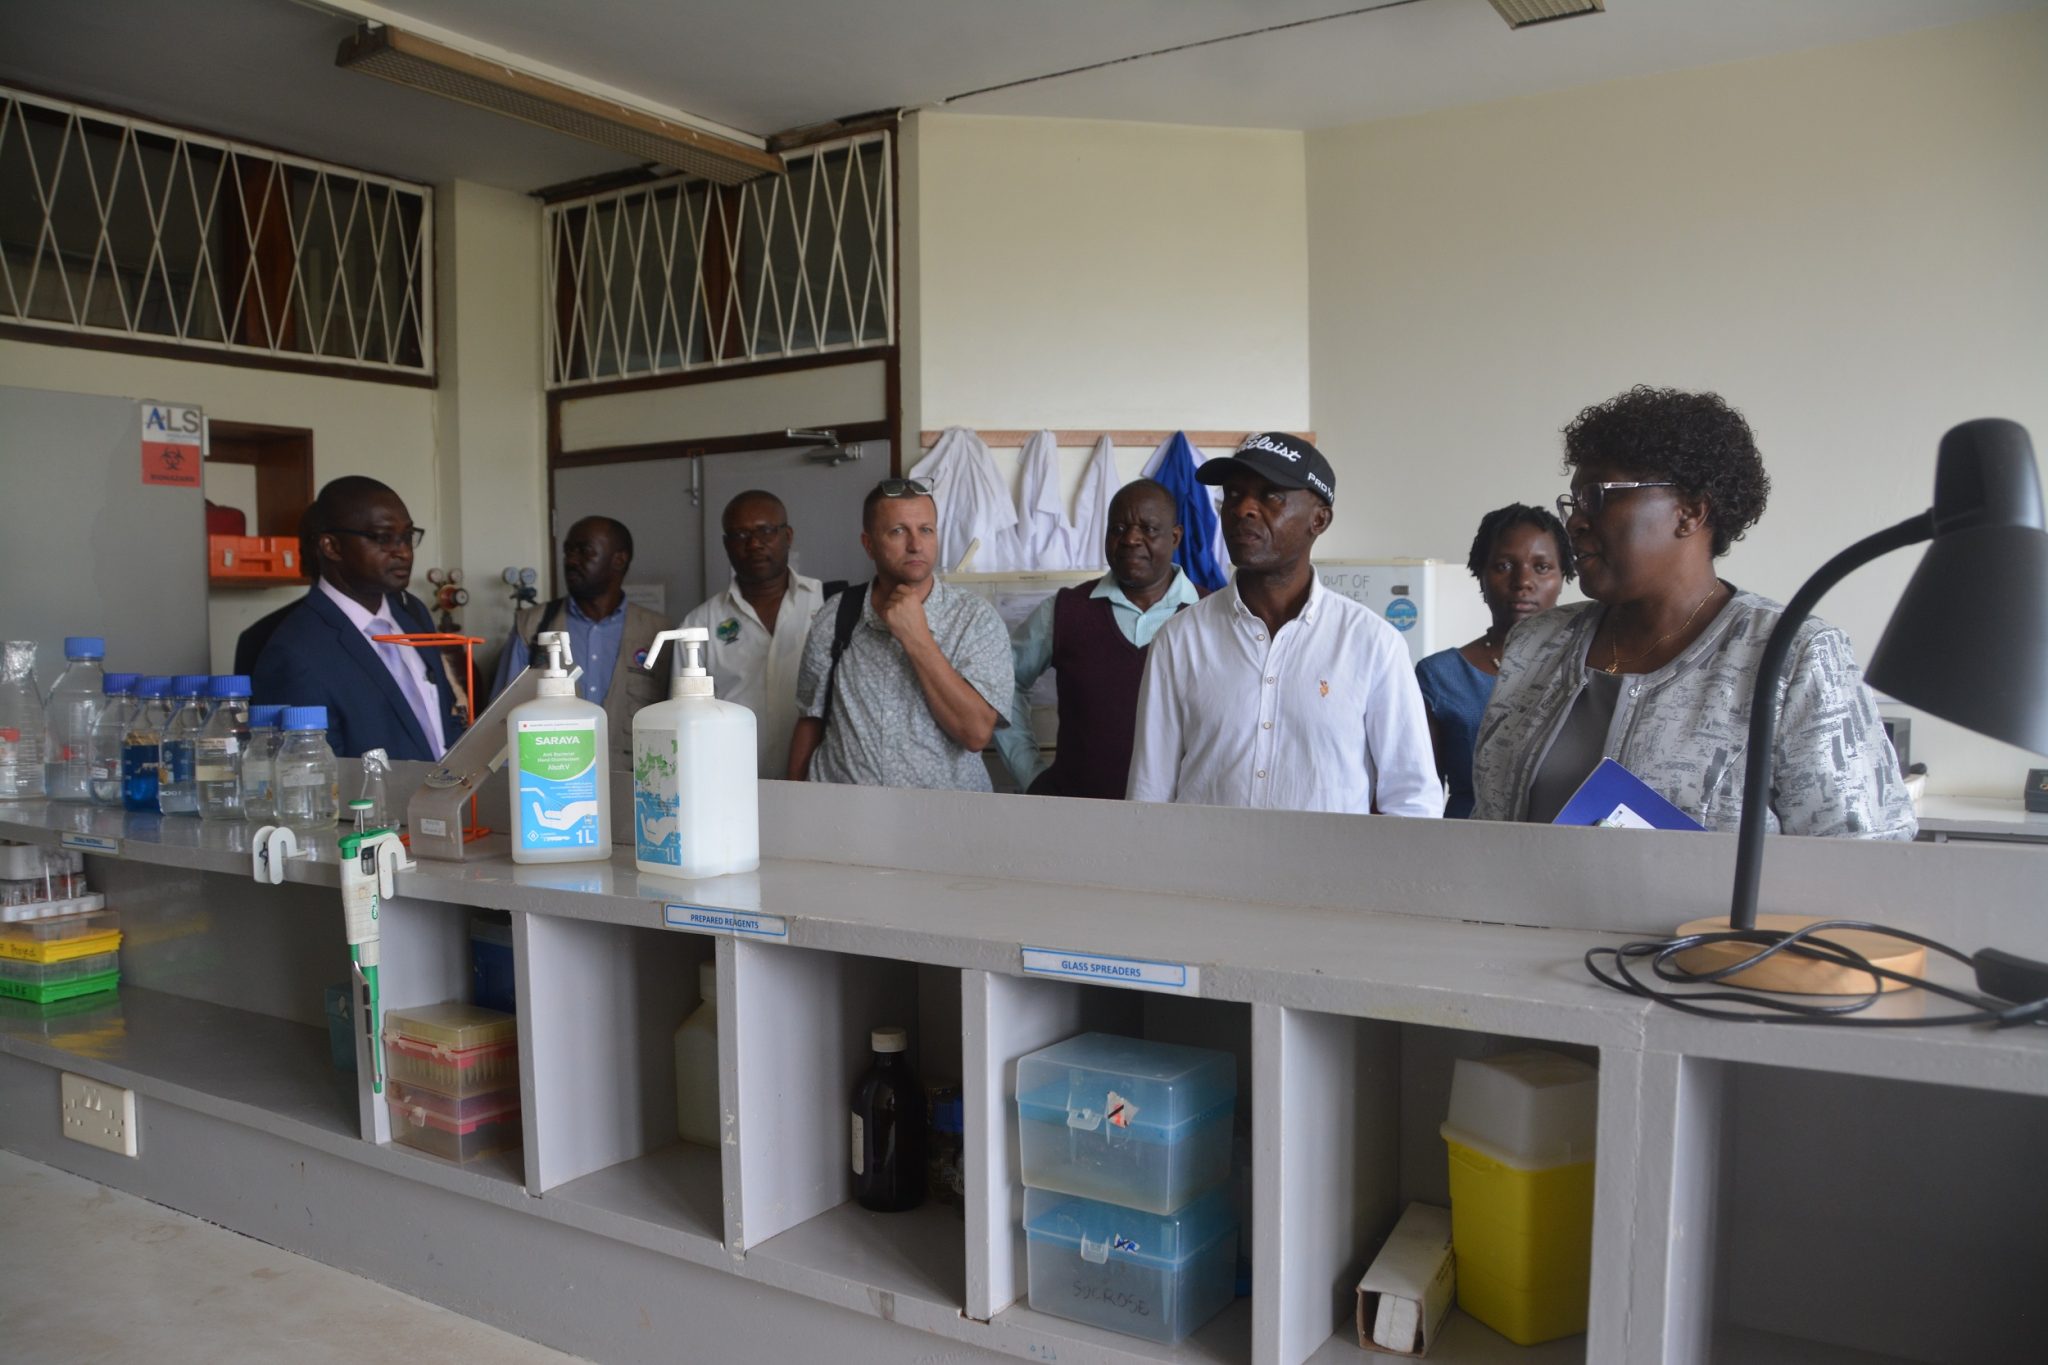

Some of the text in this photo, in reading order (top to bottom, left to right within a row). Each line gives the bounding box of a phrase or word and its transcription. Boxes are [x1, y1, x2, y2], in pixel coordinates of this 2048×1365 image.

[146, 407, 200, 433] ALS
[1323, 574, 1370, 589] OUT OF
[535, 736, 580, 746] SARAYA
[690, 914, 759, 929] PREPARED REAGENTS
[1061, 960, 1141, 977] GLASS SPREADERS
